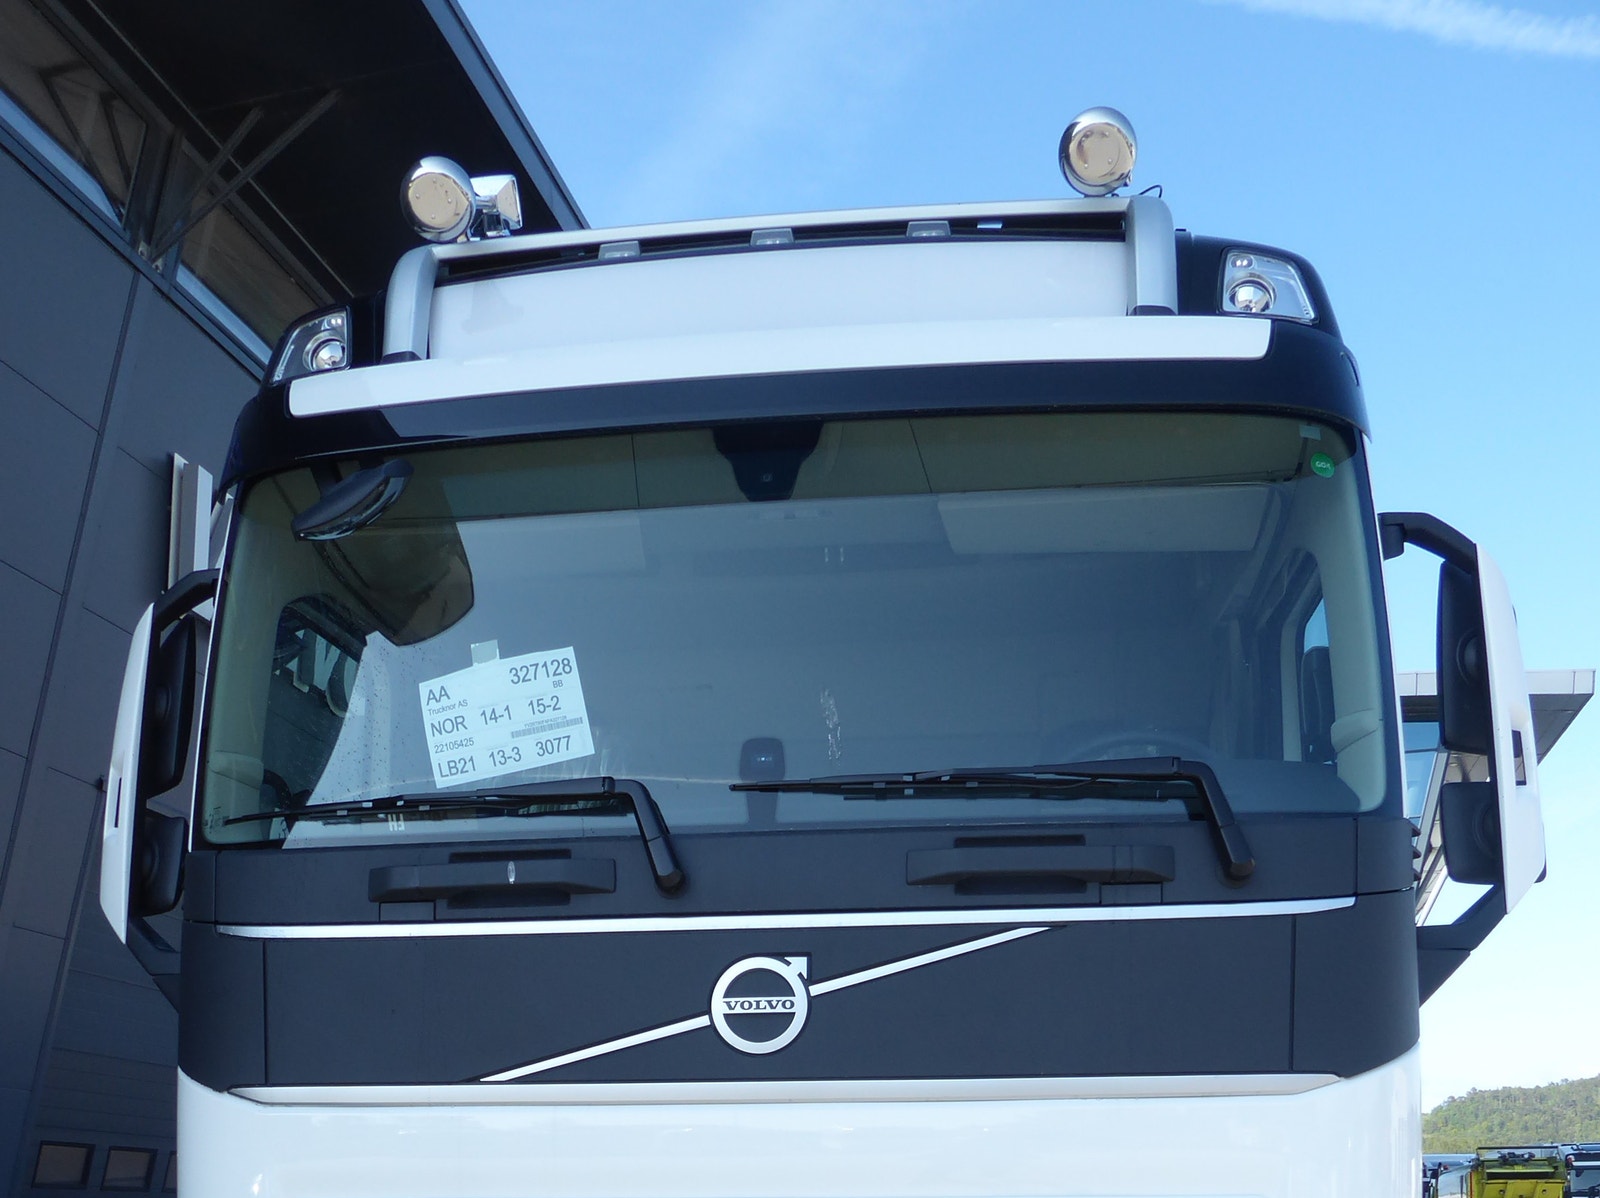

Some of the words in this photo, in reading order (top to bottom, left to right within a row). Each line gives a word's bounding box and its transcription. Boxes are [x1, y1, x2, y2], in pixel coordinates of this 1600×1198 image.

[509, 657, 573, 685] 327128
[552, 679, 564, 689] BB
[426, 685, 451, 706] AA
[457, 699, 469, 709] AS
[528, 695, 562, 716] 15-2
[480, 704, 513, 726] 14-1
[430, 715, 468, 738] NOR
[434, 737, 475, 754] 22105425
[535, 735, 572, 757] 3077
[437, 755, 477, 778] LB21
[489, 746, 522, 767] 13-3
[722, 999, 795, 1011] VOLVO
